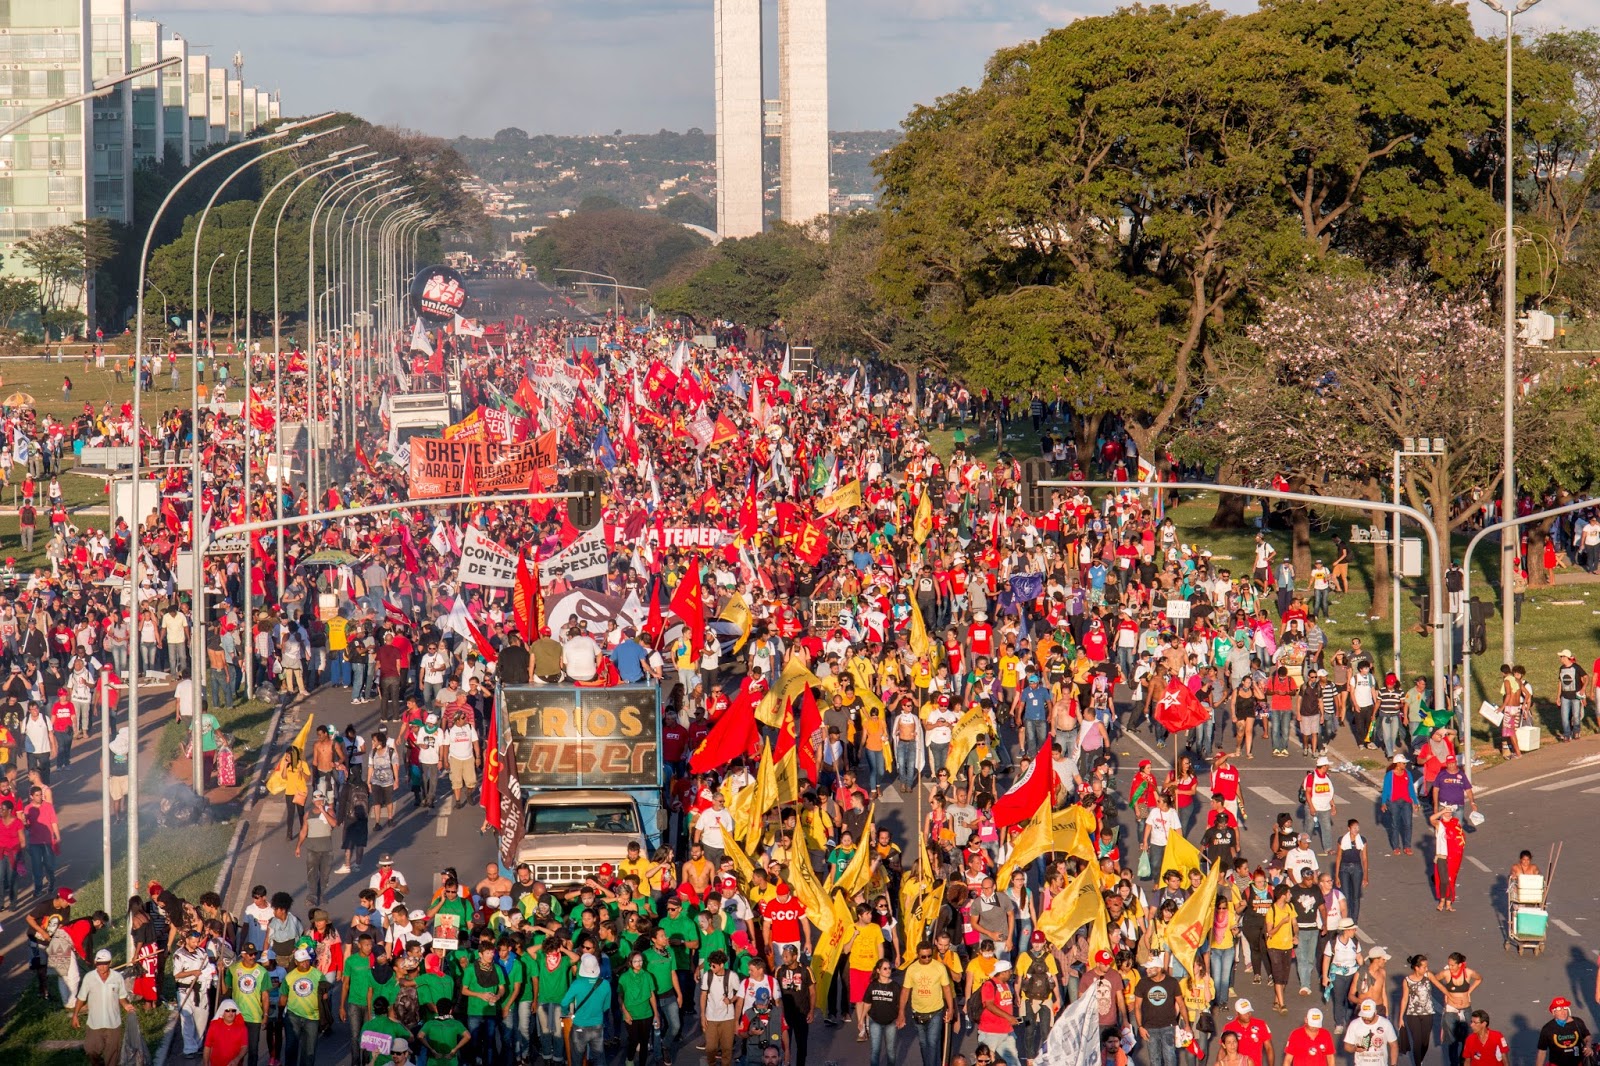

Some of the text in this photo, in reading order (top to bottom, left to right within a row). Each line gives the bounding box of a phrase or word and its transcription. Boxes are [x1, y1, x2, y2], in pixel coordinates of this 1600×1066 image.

[422, 299, 458, 315] unidos
[485, 419, 519, 439] GERL
[426, 439, 544, 465] GREVE GERAL
[418, 453, 551, 479] PARA DERUBAR TEMER
[476, 474, 525, 488] EFORMAS
[614, 526, 660, 546] FA
[468, 562, 487, 576] DE
[1163, 694, 1177, 706] PT
[509, 705, 643, 738] TRIOS
